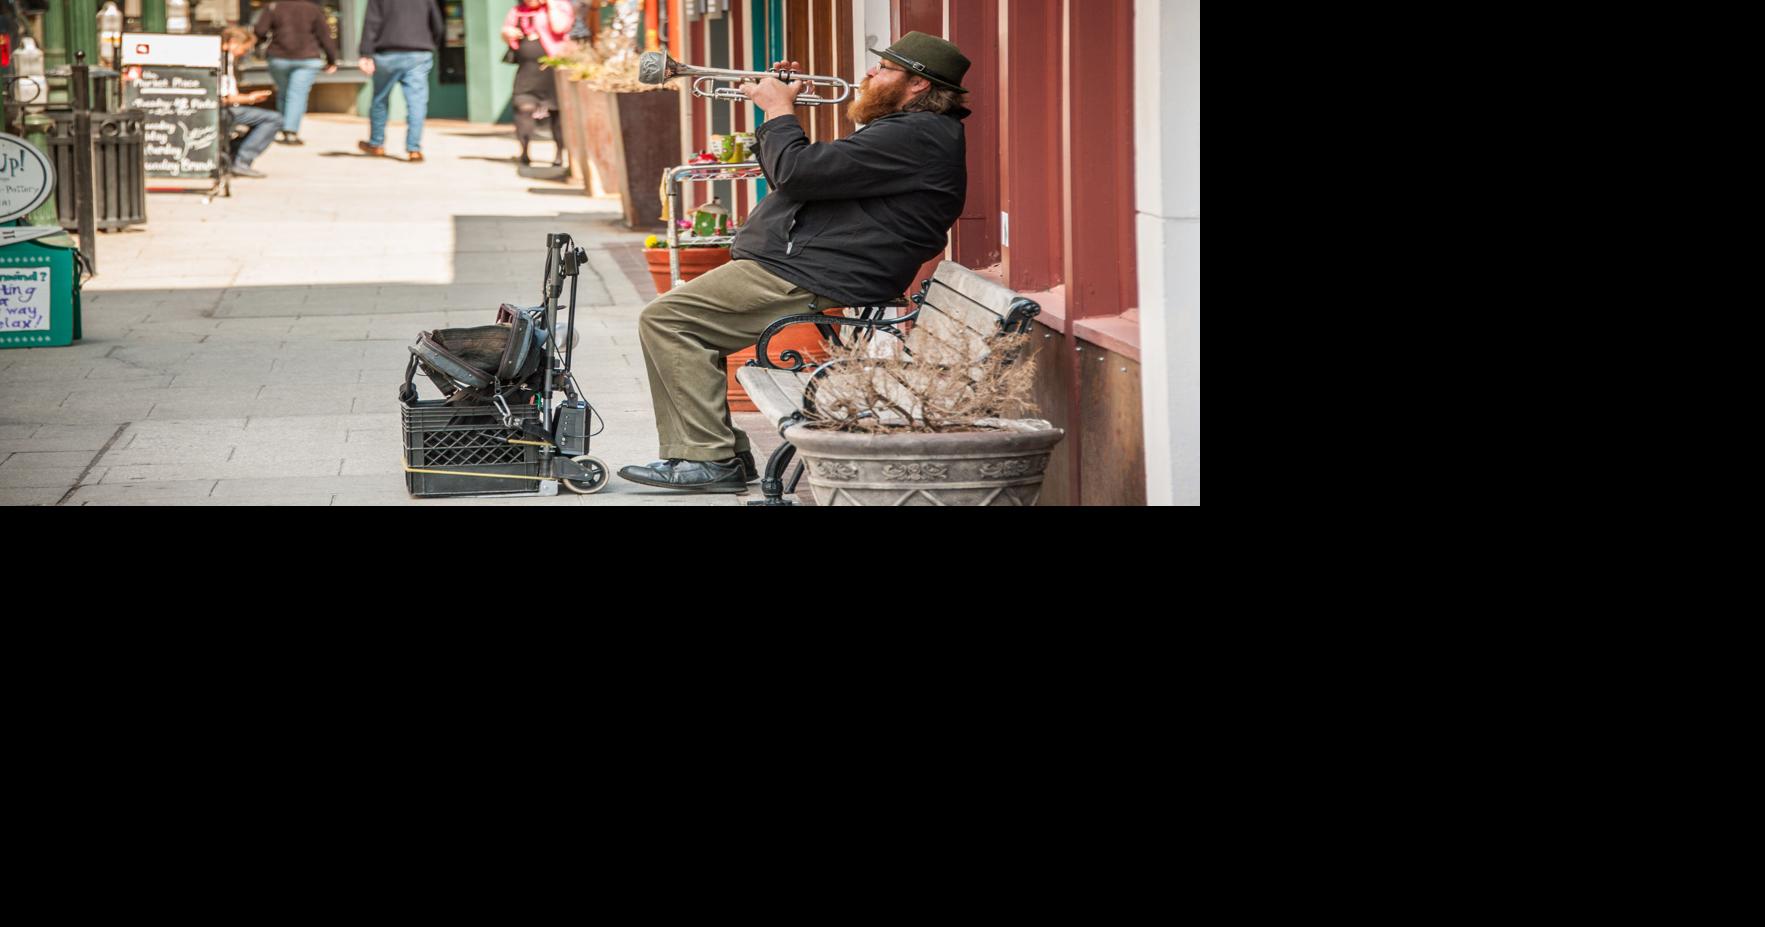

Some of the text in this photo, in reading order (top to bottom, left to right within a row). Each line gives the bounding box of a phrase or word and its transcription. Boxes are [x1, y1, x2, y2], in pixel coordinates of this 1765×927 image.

[144, 159, 180, 176] unday
[6, 307, 37, 319] way
[0, 316, 43, 329] elax!
